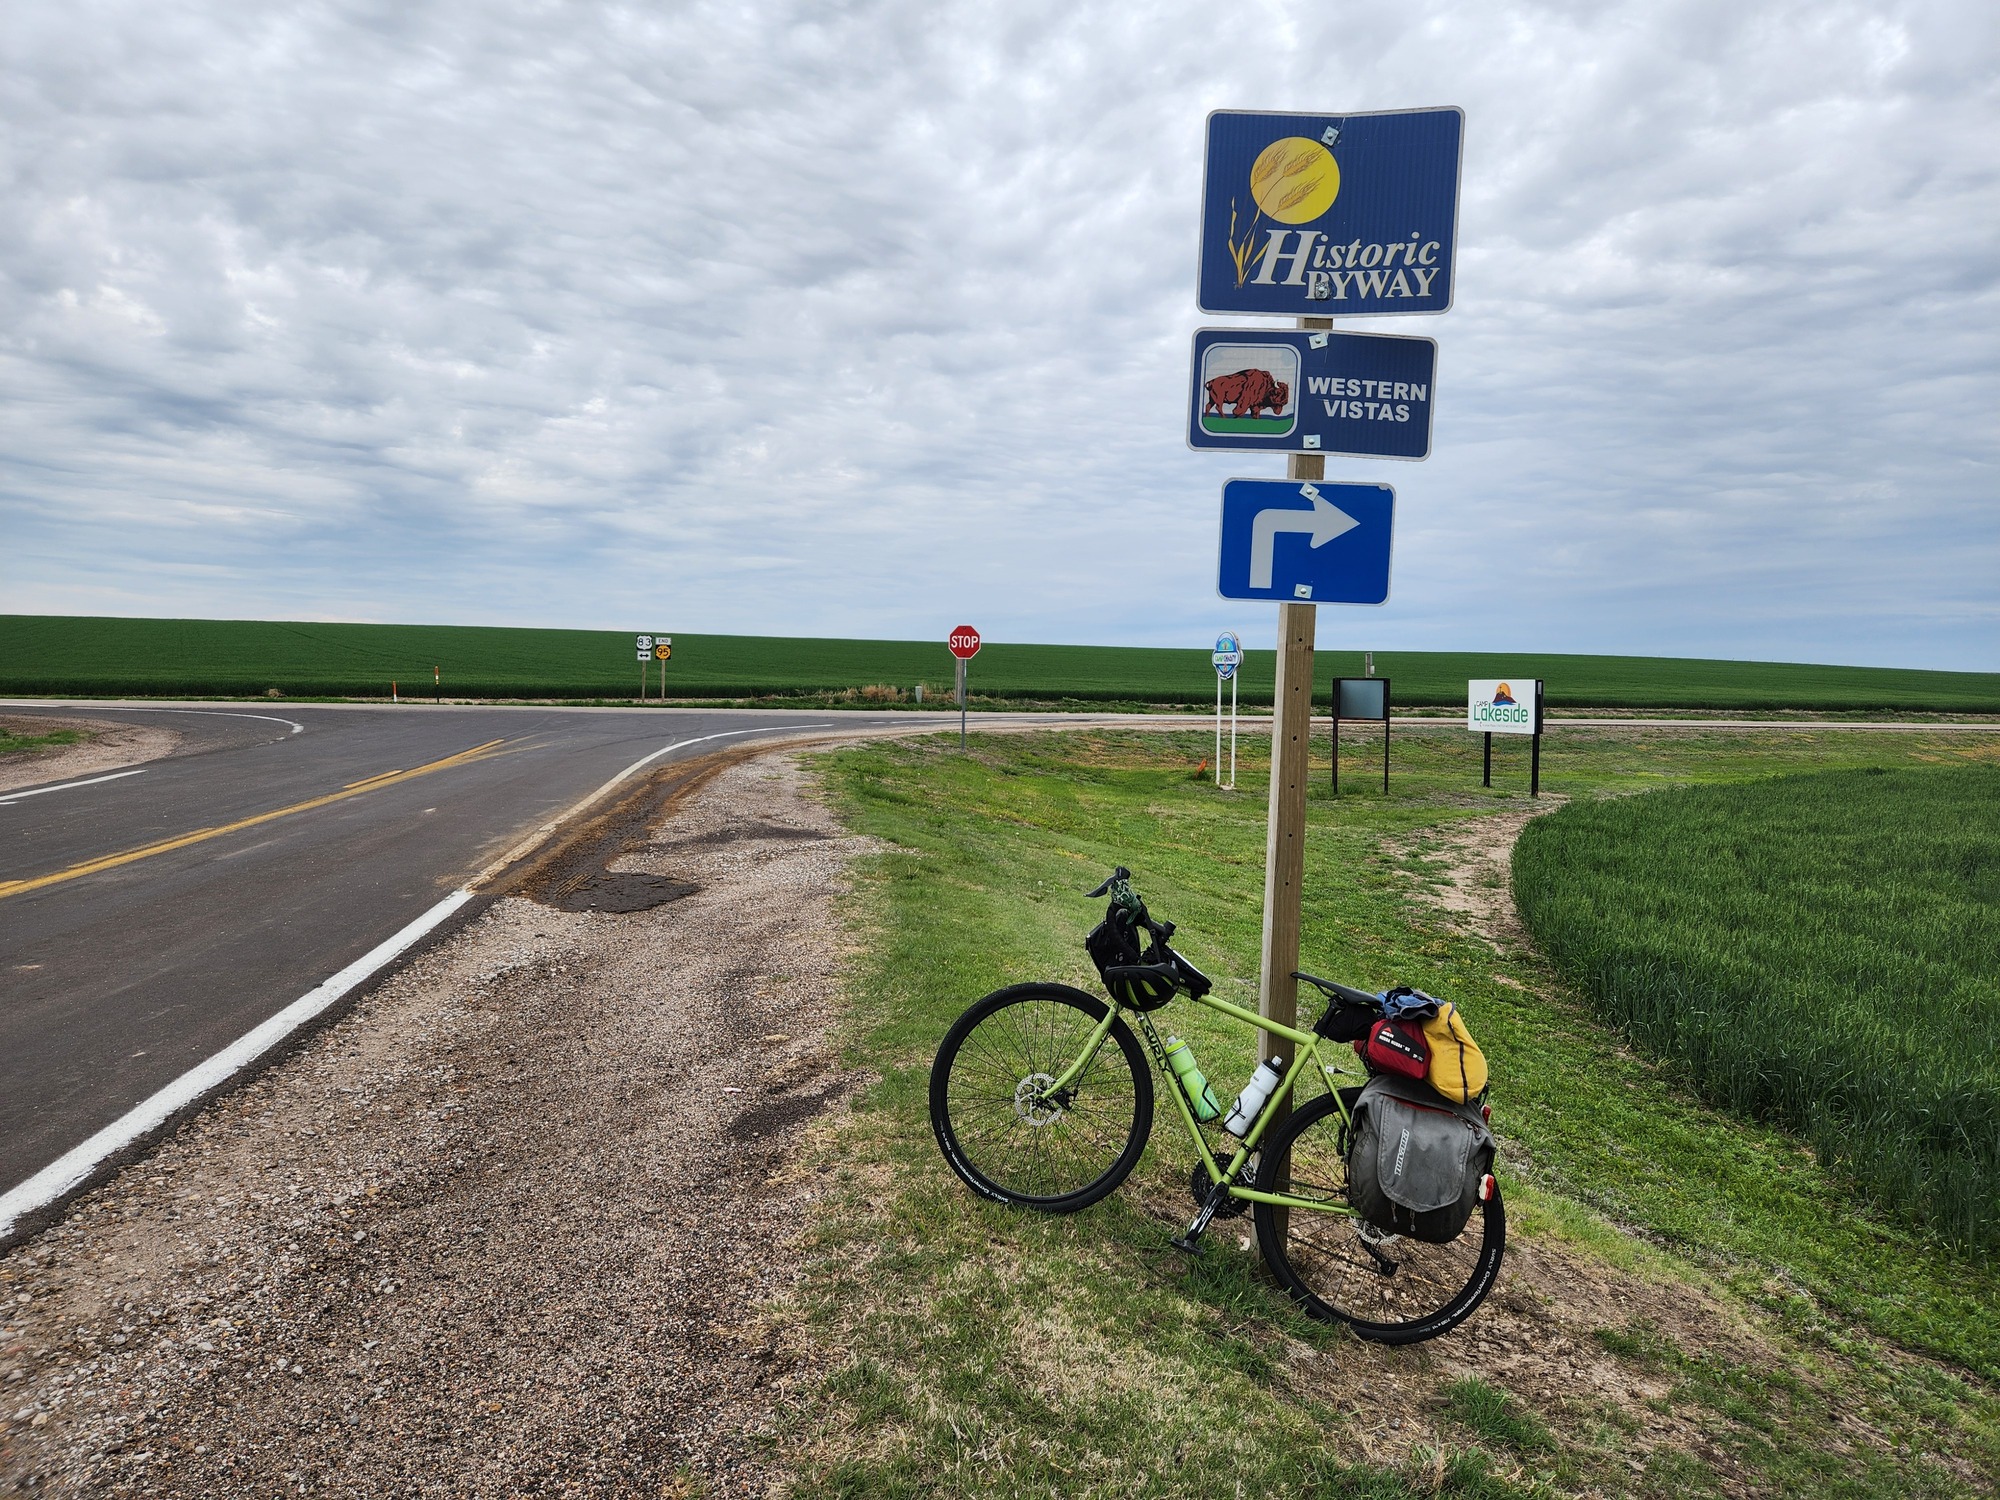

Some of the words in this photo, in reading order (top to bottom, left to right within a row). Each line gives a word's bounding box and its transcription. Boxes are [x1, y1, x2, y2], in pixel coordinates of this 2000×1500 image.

[1250, 229, 1441, 286] Historic
[1304, 268, 1441, 300] BYWAY
[1308, 376, 1427, 402] WESTERN
[1323, 399, 1411, 423] VISTAS
[638, 637, 651, 647] 83
[657, 647, 670, 657] 95
[950, 635, 979, 649] STOP
[1473, 702, 1529, 723] Lakeside
[1475, 700, 1489, 708] CAMP
[1143, 1025, 1171, 1073] SURLY
